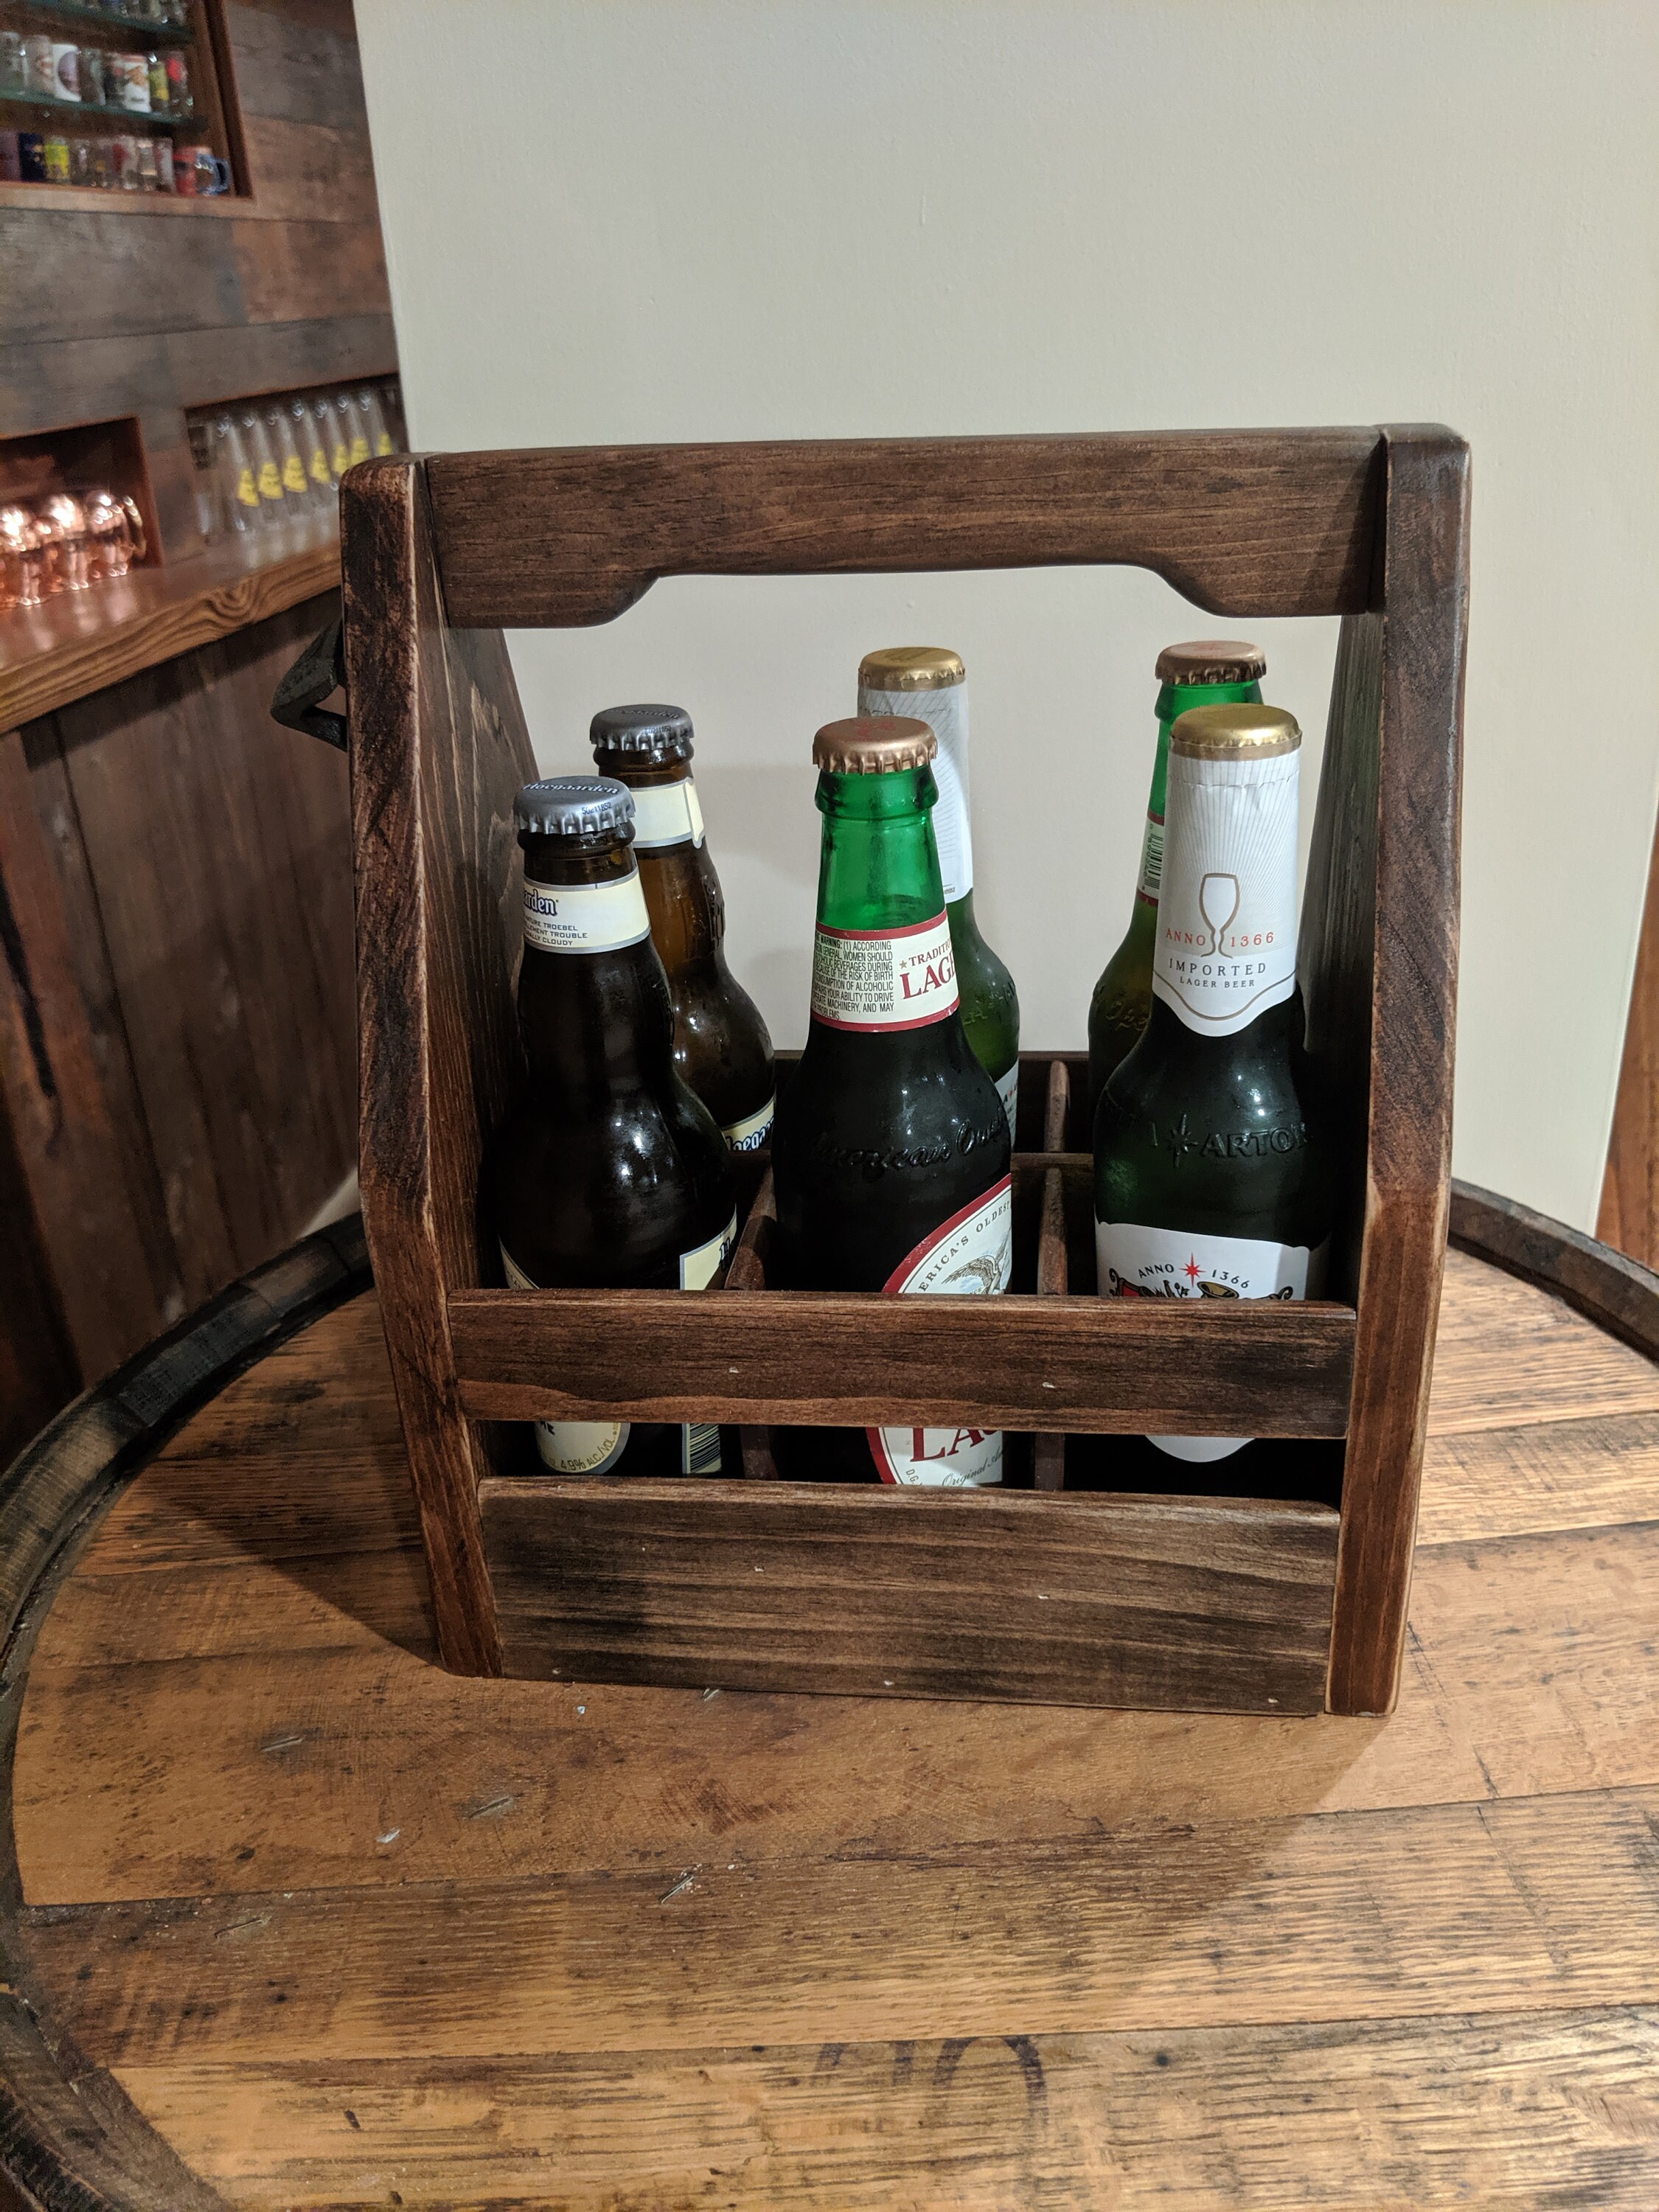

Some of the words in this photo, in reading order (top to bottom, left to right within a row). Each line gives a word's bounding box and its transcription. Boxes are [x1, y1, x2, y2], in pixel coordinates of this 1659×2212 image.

[543, 922, 578, 931] TROEBEL
[542, 937, 573, 946] CLOUDY
[550, 931, 588, 939] TROUBLE
[1165, 928, 1206, 946] ANNO
[1230, 932, 1275, 947] 1366
[844, 940, 852, 952] (1)
[852, 940, 891, 951] ACCORDING
[908, 938, 951, 967] TRADITIO
[843, 951, 866, 961] WOMEN
[867, 951, 893, 961] SHOULD
[833, 960, 866, 971] BEVERAGES
[867, 961, 893, 972] DURING
[1169, 958, 1267, 976] IMPORTED
[838, 968, 848, 980] THE
[849, 970, 863, 981] RISK
[864, 971, 873, 981] OF
[874, 970, 894, 981] BIRTH
[846, 981, 855, 991] OF
[855, 981, 894, 992] ALCOHOLIC
[1180, 976, 1217, 988] LAGER
[1224, 979, 1255, 989] BEER
[827, 988, 840, 999] YOUR
[841, 991, 863, 1002] ABILITY
[864, 992, 873, 1003] TO
[874, 992, 894, 1002] DRIVE
[827, 998, 862, 1014] MACHINERY,
[863, 1003, 877, 1013] AND
[880, 1002, 894, 1012] MAY
[916, 1235, 970, 1293] ERICA'S
[1138, 1263, 1175, 1279] ANNO
[1211, 1269, 1251, 1289] 1366
[560, 1458, 587, 1471] 4.9%
